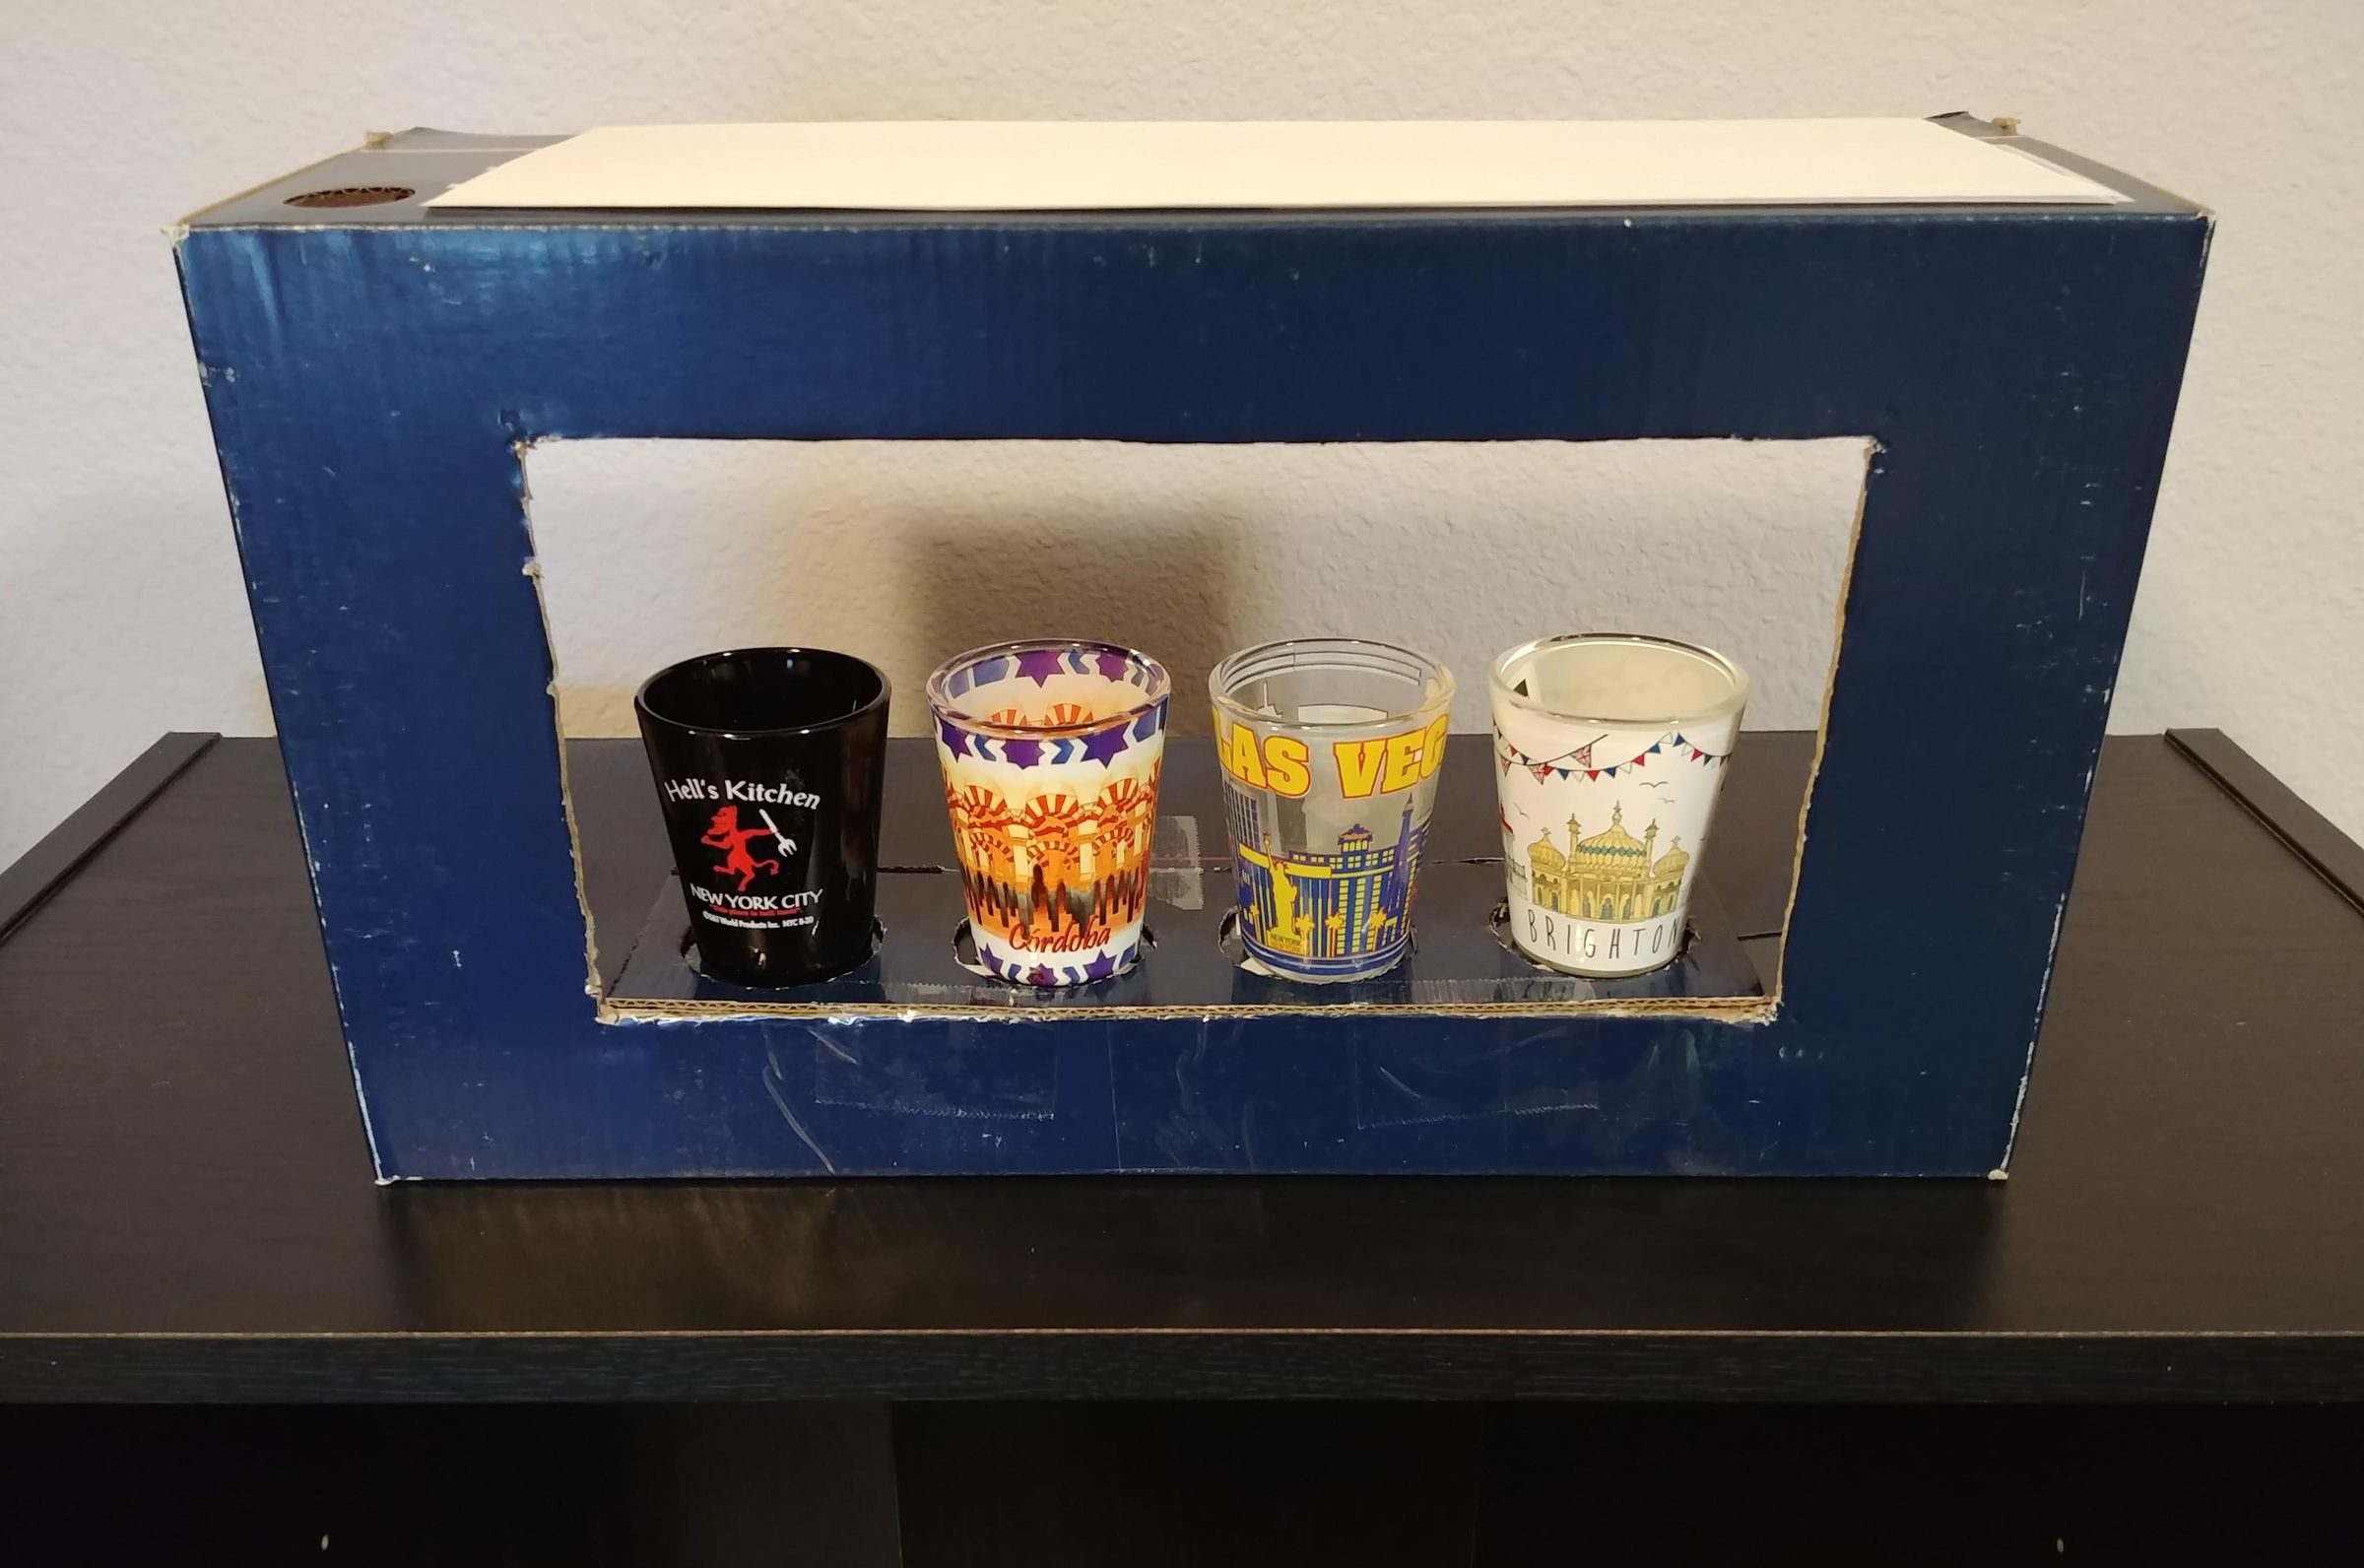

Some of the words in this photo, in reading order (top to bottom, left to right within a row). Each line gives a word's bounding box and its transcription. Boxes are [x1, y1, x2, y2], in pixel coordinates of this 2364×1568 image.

[1213, 704, 1312, 798] LAS
[664, 778, 720, 803] Hell's
[724, 779, 821, 810] Kitchen
[690, 882, 724, 906] NEW
[724, 893, 779, 910] YORK
[781, 888, 823, 908] CITY
[1009, 914, 1112, 953] Córdoba
[1528, 908, 1681, 958] BRIGHTON
